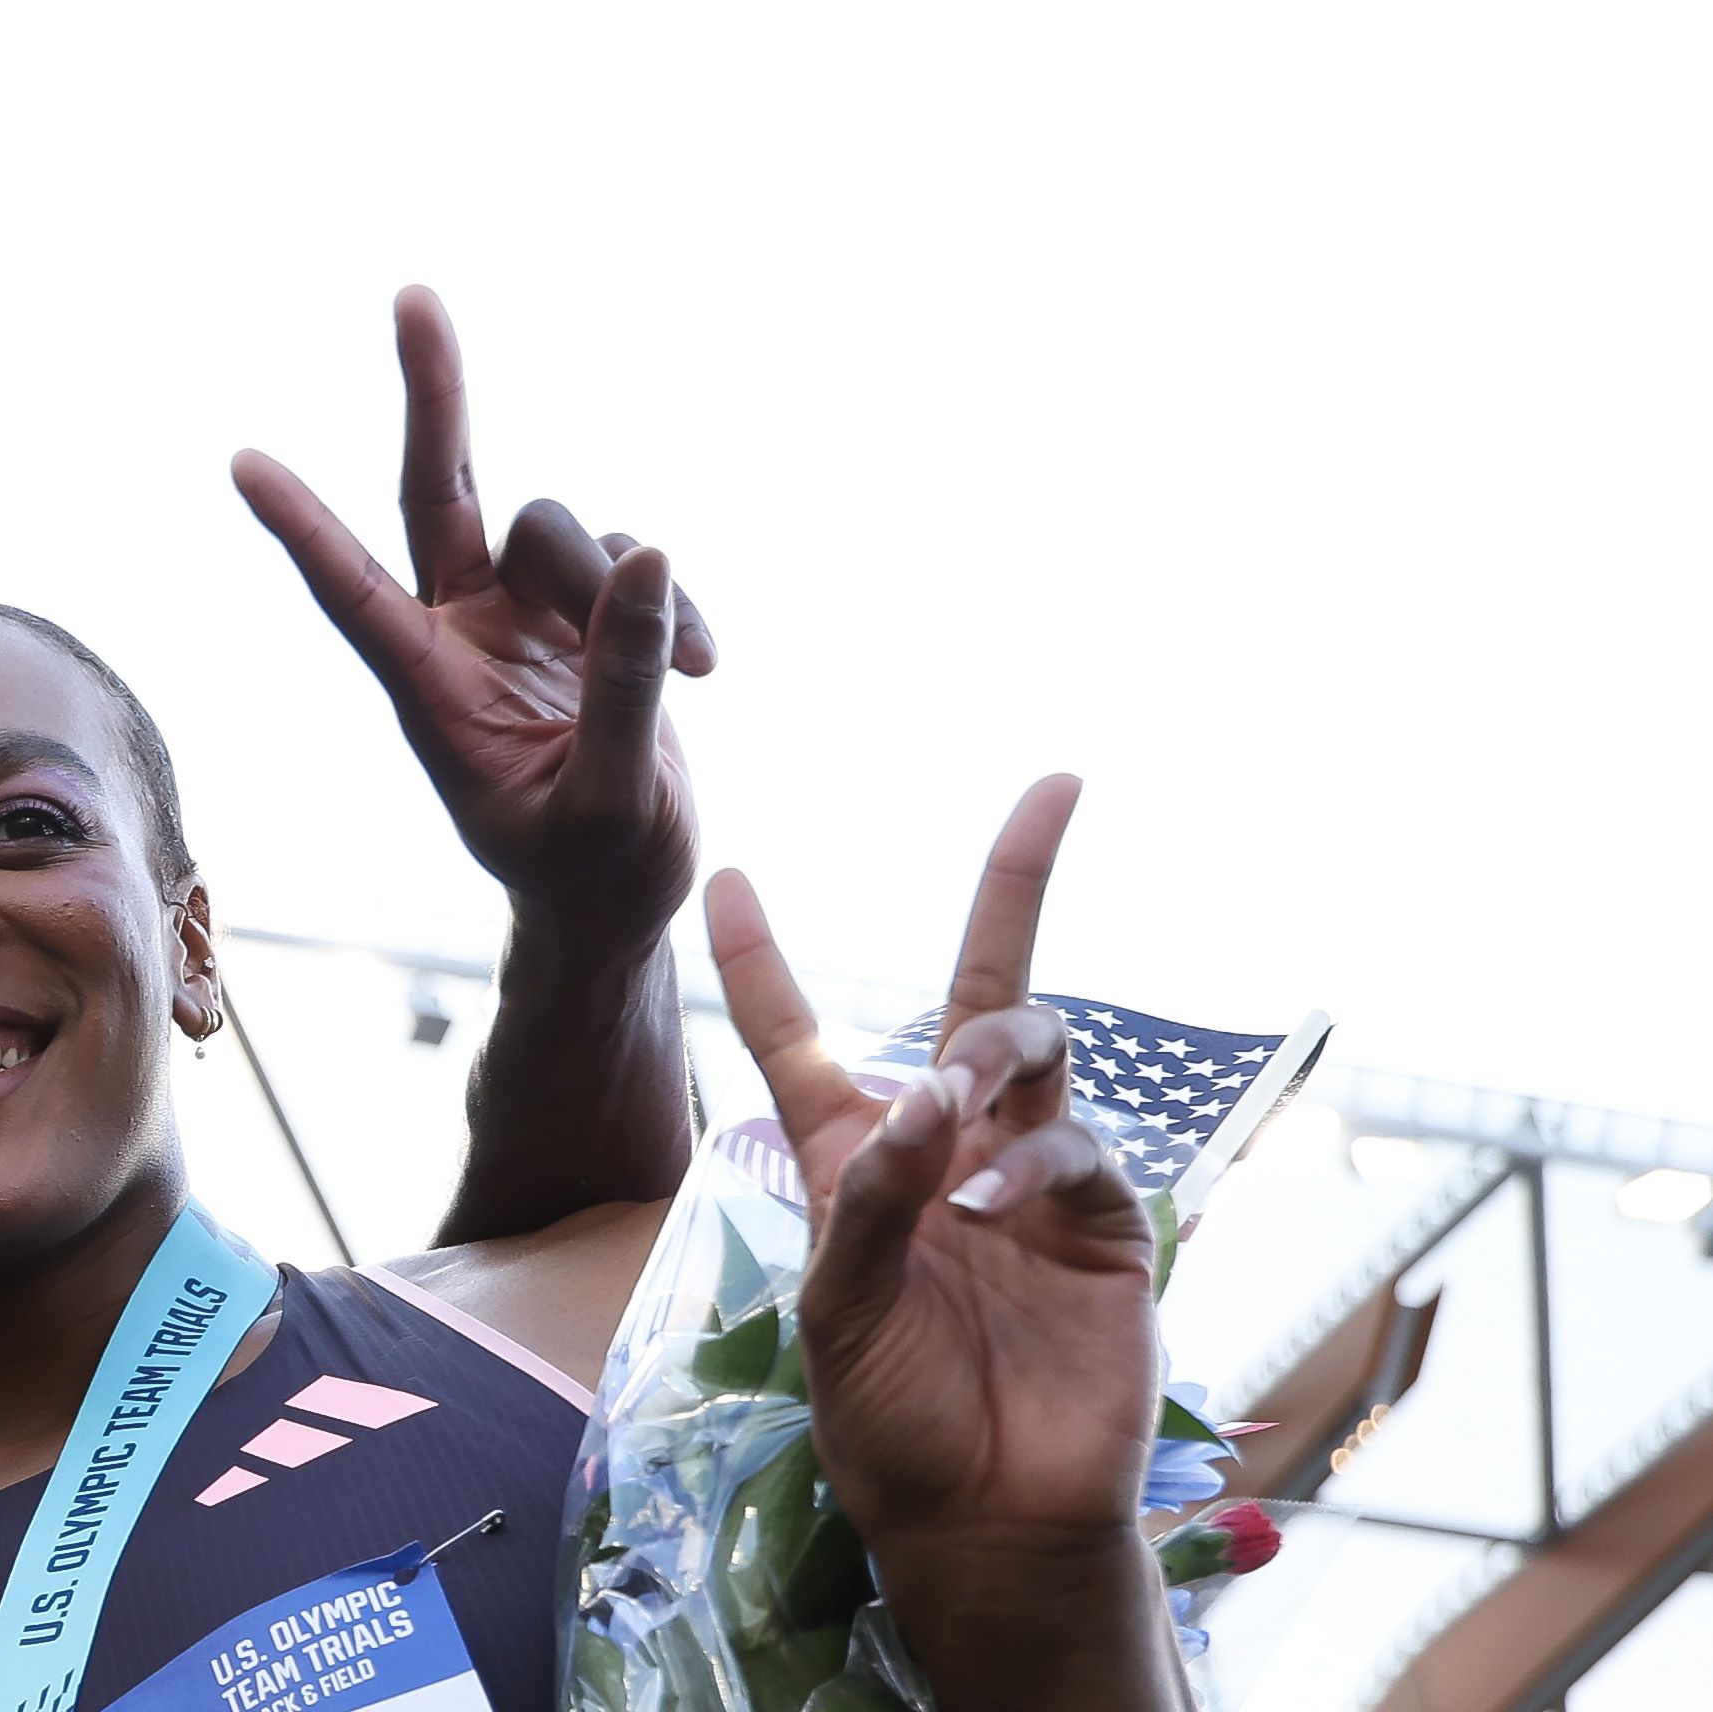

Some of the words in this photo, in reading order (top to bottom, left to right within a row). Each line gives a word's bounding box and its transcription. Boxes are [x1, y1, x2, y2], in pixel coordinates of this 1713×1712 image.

[143, 1277, 228, 1357] TRIALS
[103, 1365, 182, 1437] TEAM
[46, 1442, 137, 1573] OLYMPIC
[19, 1579, 79, 1646] U.S.
[210, 1639, 268, 1685] U.S.
[269, 1581, 402, 1652] OLYMPIC
[302, 1609, 414, 1672] TRIALS
[300, 1684, 319, 1705] &
[319, 1658, 375, 1697] FIELD
